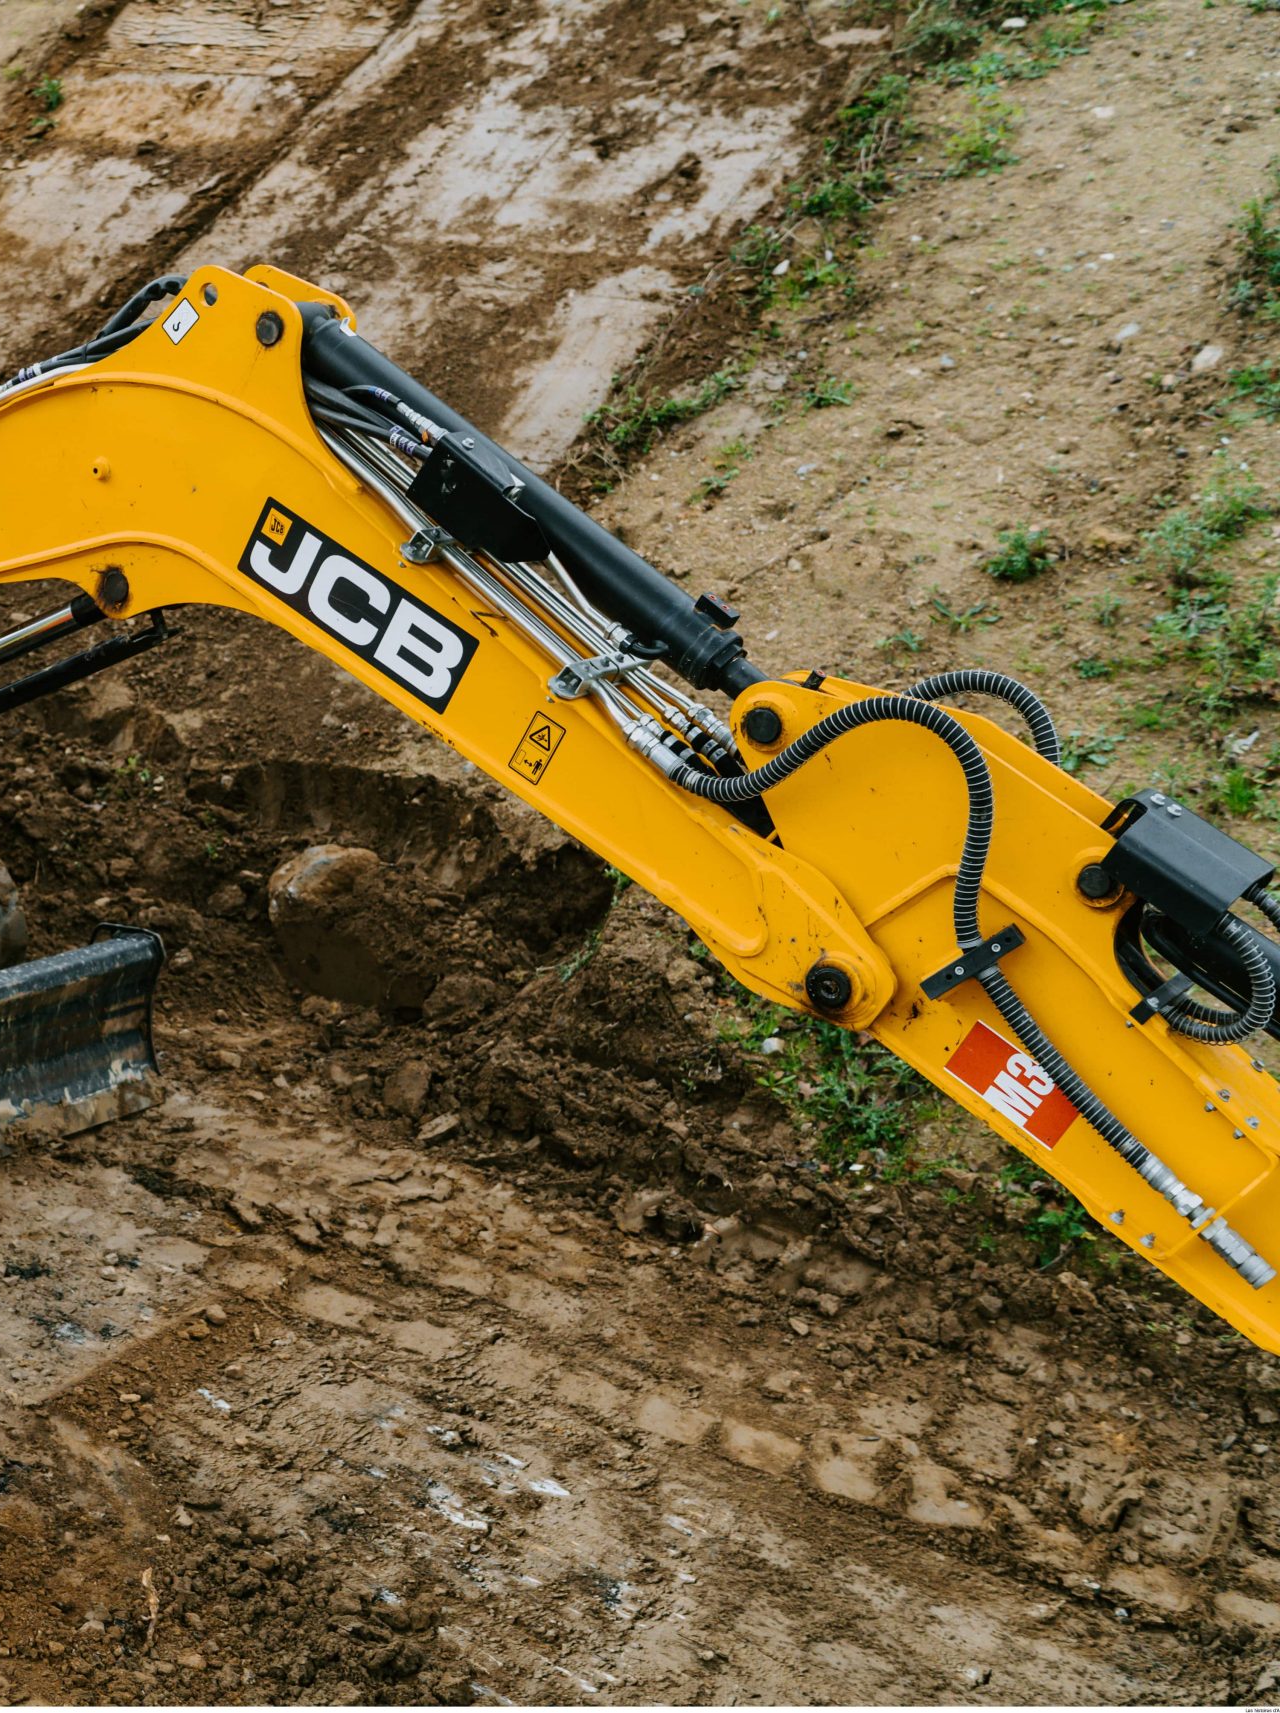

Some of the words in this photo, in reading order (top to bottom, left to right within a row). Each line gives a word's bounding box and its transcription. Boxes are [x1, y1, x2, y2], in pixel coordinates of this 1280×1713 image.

[270, 518, 285, 534] JCB
[249, 531, 464, 698] JCB
[981, 1053, 1055, 1128] M3
